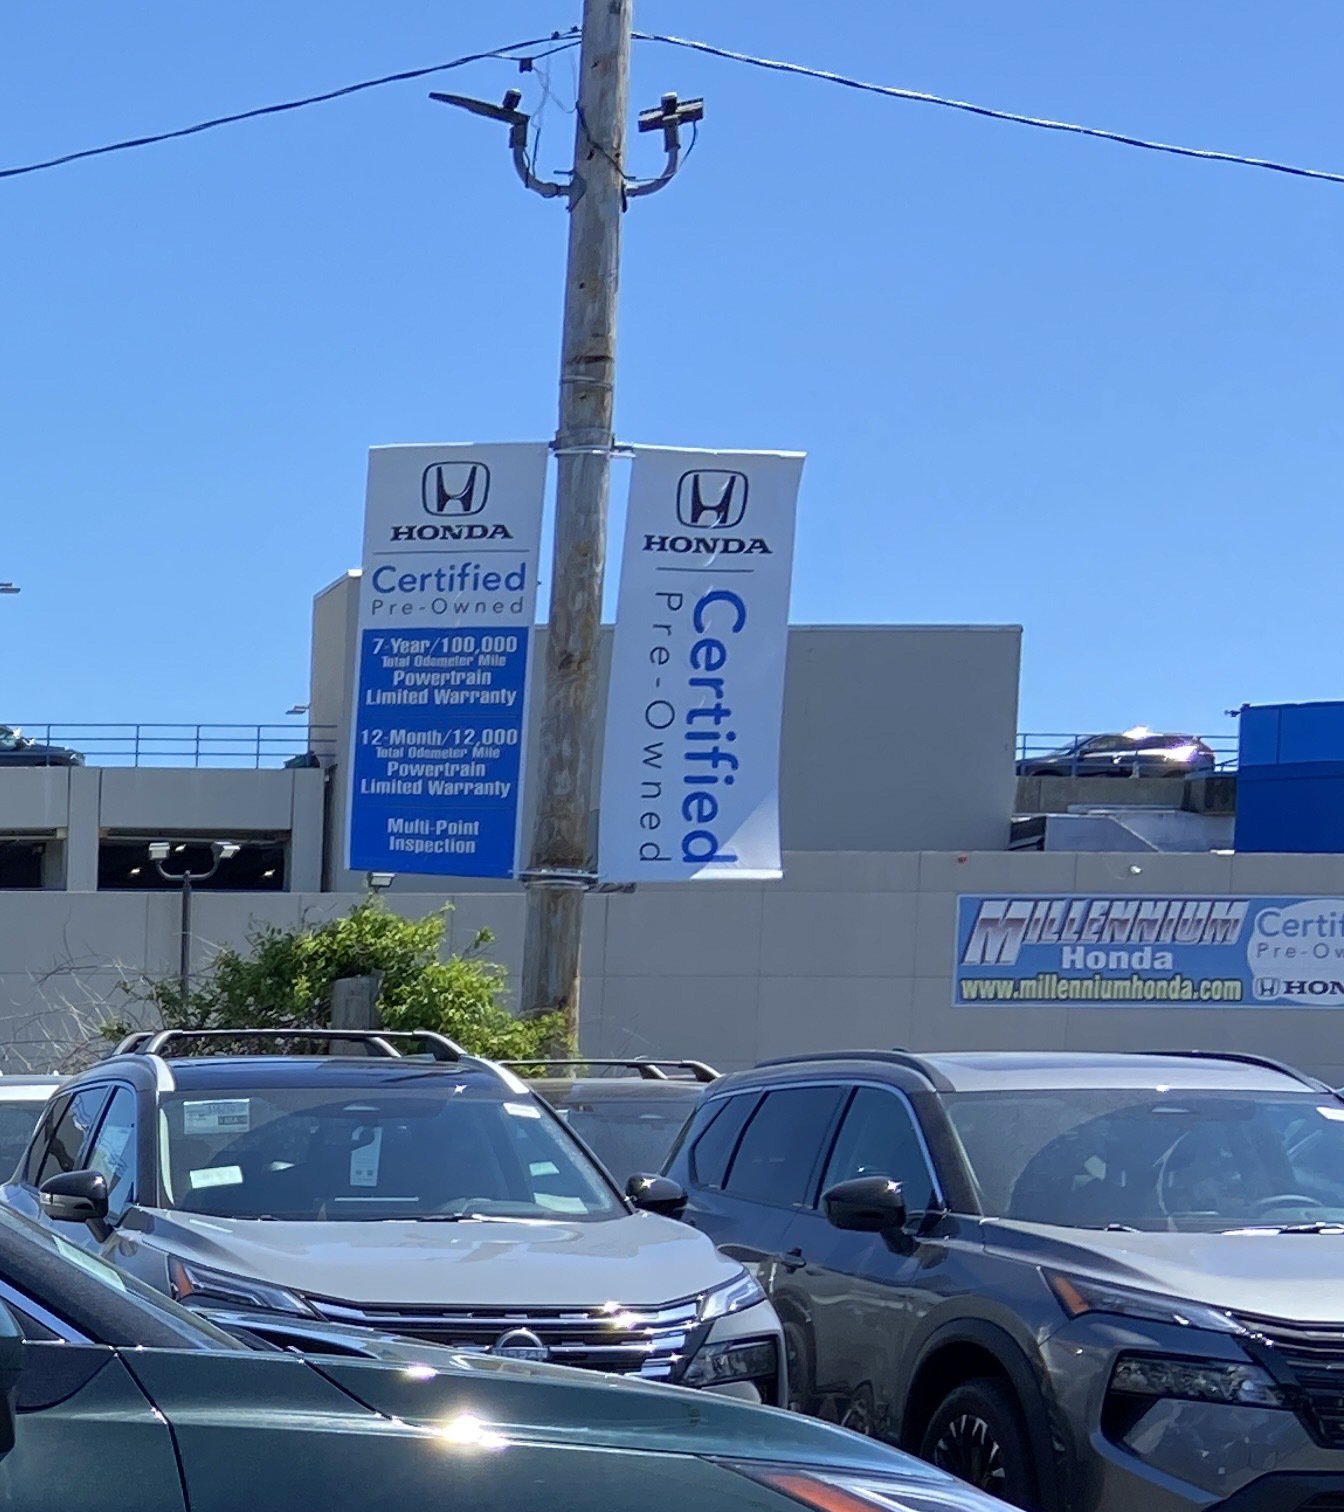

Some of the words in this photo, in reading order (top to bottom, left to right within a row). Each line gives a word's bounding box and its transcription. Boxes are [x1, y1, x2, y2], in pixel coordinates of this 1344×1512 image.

[390, 524, 513, 541] HONDA
[642, 534, 773, 554] HONDA
[372, 562, 526, 593] Certified
[371, 597, 524, 615] Pre-Owned
[372, 636, 518, 655] 7-Year/100,000
[382, 655, 410, 668] Total
[414, 655, 474, 667] Odometer
[478, 654, 506, 667] Mile
[393, 669, 492, 686] Powertrain
[366, 689, 429, 705] Limited
[434, 688, 517, 706] Warranty
[639, 592, 683, 861] Pre-Owned
[681, 590, 746, 863] Certified
[361, 728, 518, 747] 12-Month/12,000
[375, 746, 404, 758] Total
[472, 746, 500, 759] Mile
[387, 761, 486, 777] Powertrain
[361, 778, 422, 795] Limited
[428, 780, 511, 798] Warranty
[387, 818, 480, 836] Multi-Point
[389, 836, 476, 854] Inspection
[961, 899, 1250, 967] MILLENNIUM
[1256, 910, 1344, 938] Certi
[1062, 946, 1173, 970] Honda
[961, 973, 1242, 1000] www.millenniumhonda.com
